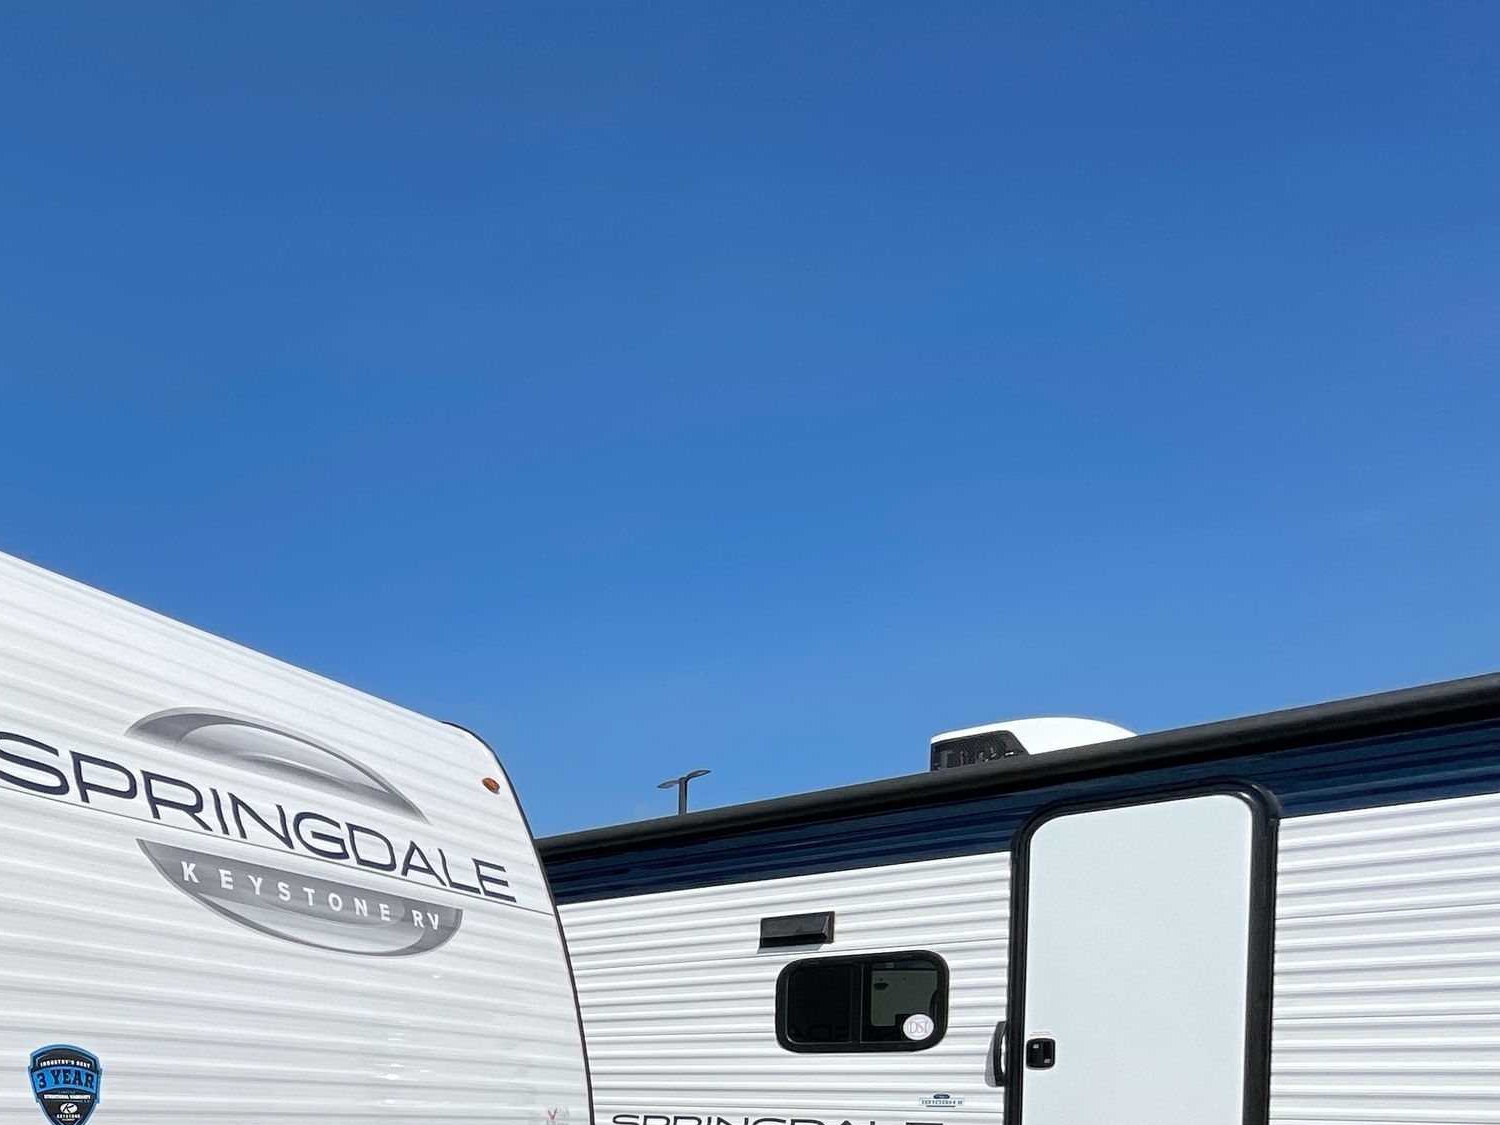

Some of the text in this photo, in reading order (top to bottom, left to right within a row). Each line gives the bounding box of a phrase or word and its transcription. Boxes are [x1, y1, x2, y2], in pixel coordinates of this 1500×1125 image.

[180, 860, 440, 931] KEYSTONE RV
[36, 1068, 95, 1089] 3 YEAR
